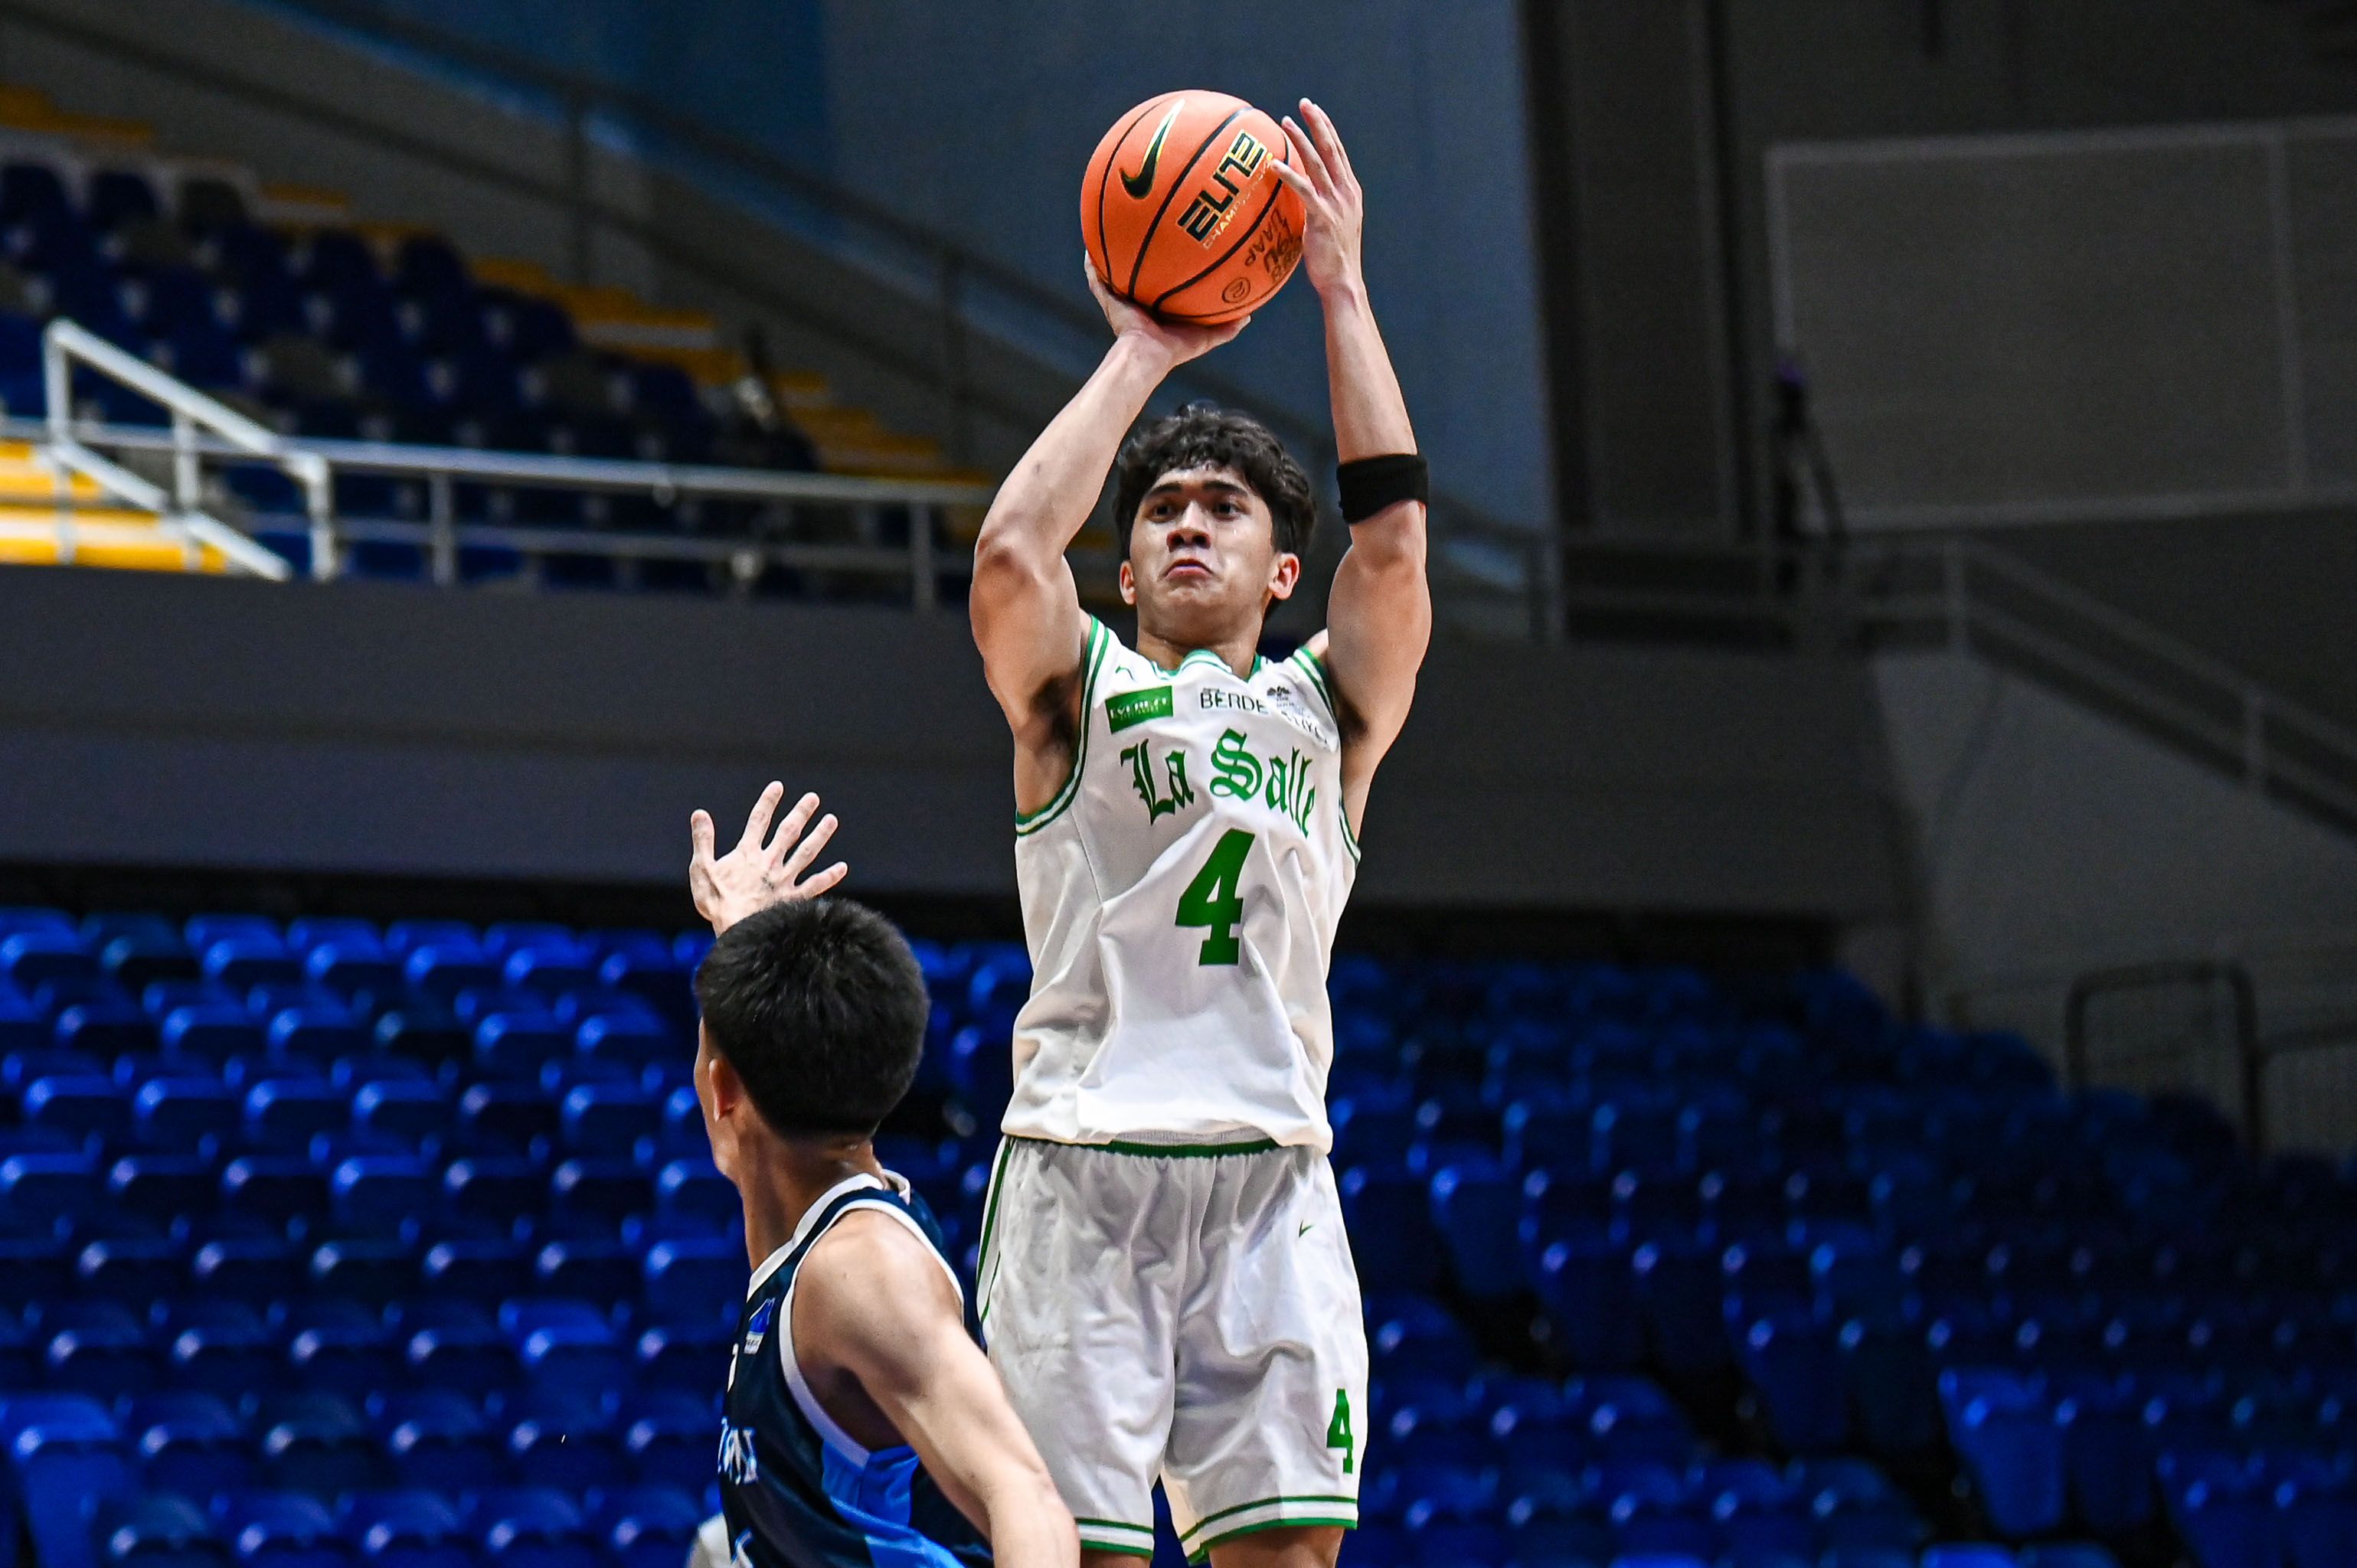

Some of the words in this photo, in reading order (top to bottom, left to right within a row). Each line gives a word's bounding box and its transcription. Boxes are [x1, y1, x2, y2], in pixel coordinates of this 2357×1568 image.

[1177, 129, 1267, 242] ELITE
[1120, 739, 1194, 825] La
[1210, 728, 1316, 838] Salle
[1175, 828, 1256, 966] 4
[1326, 1388, 1353, 1474] 4
